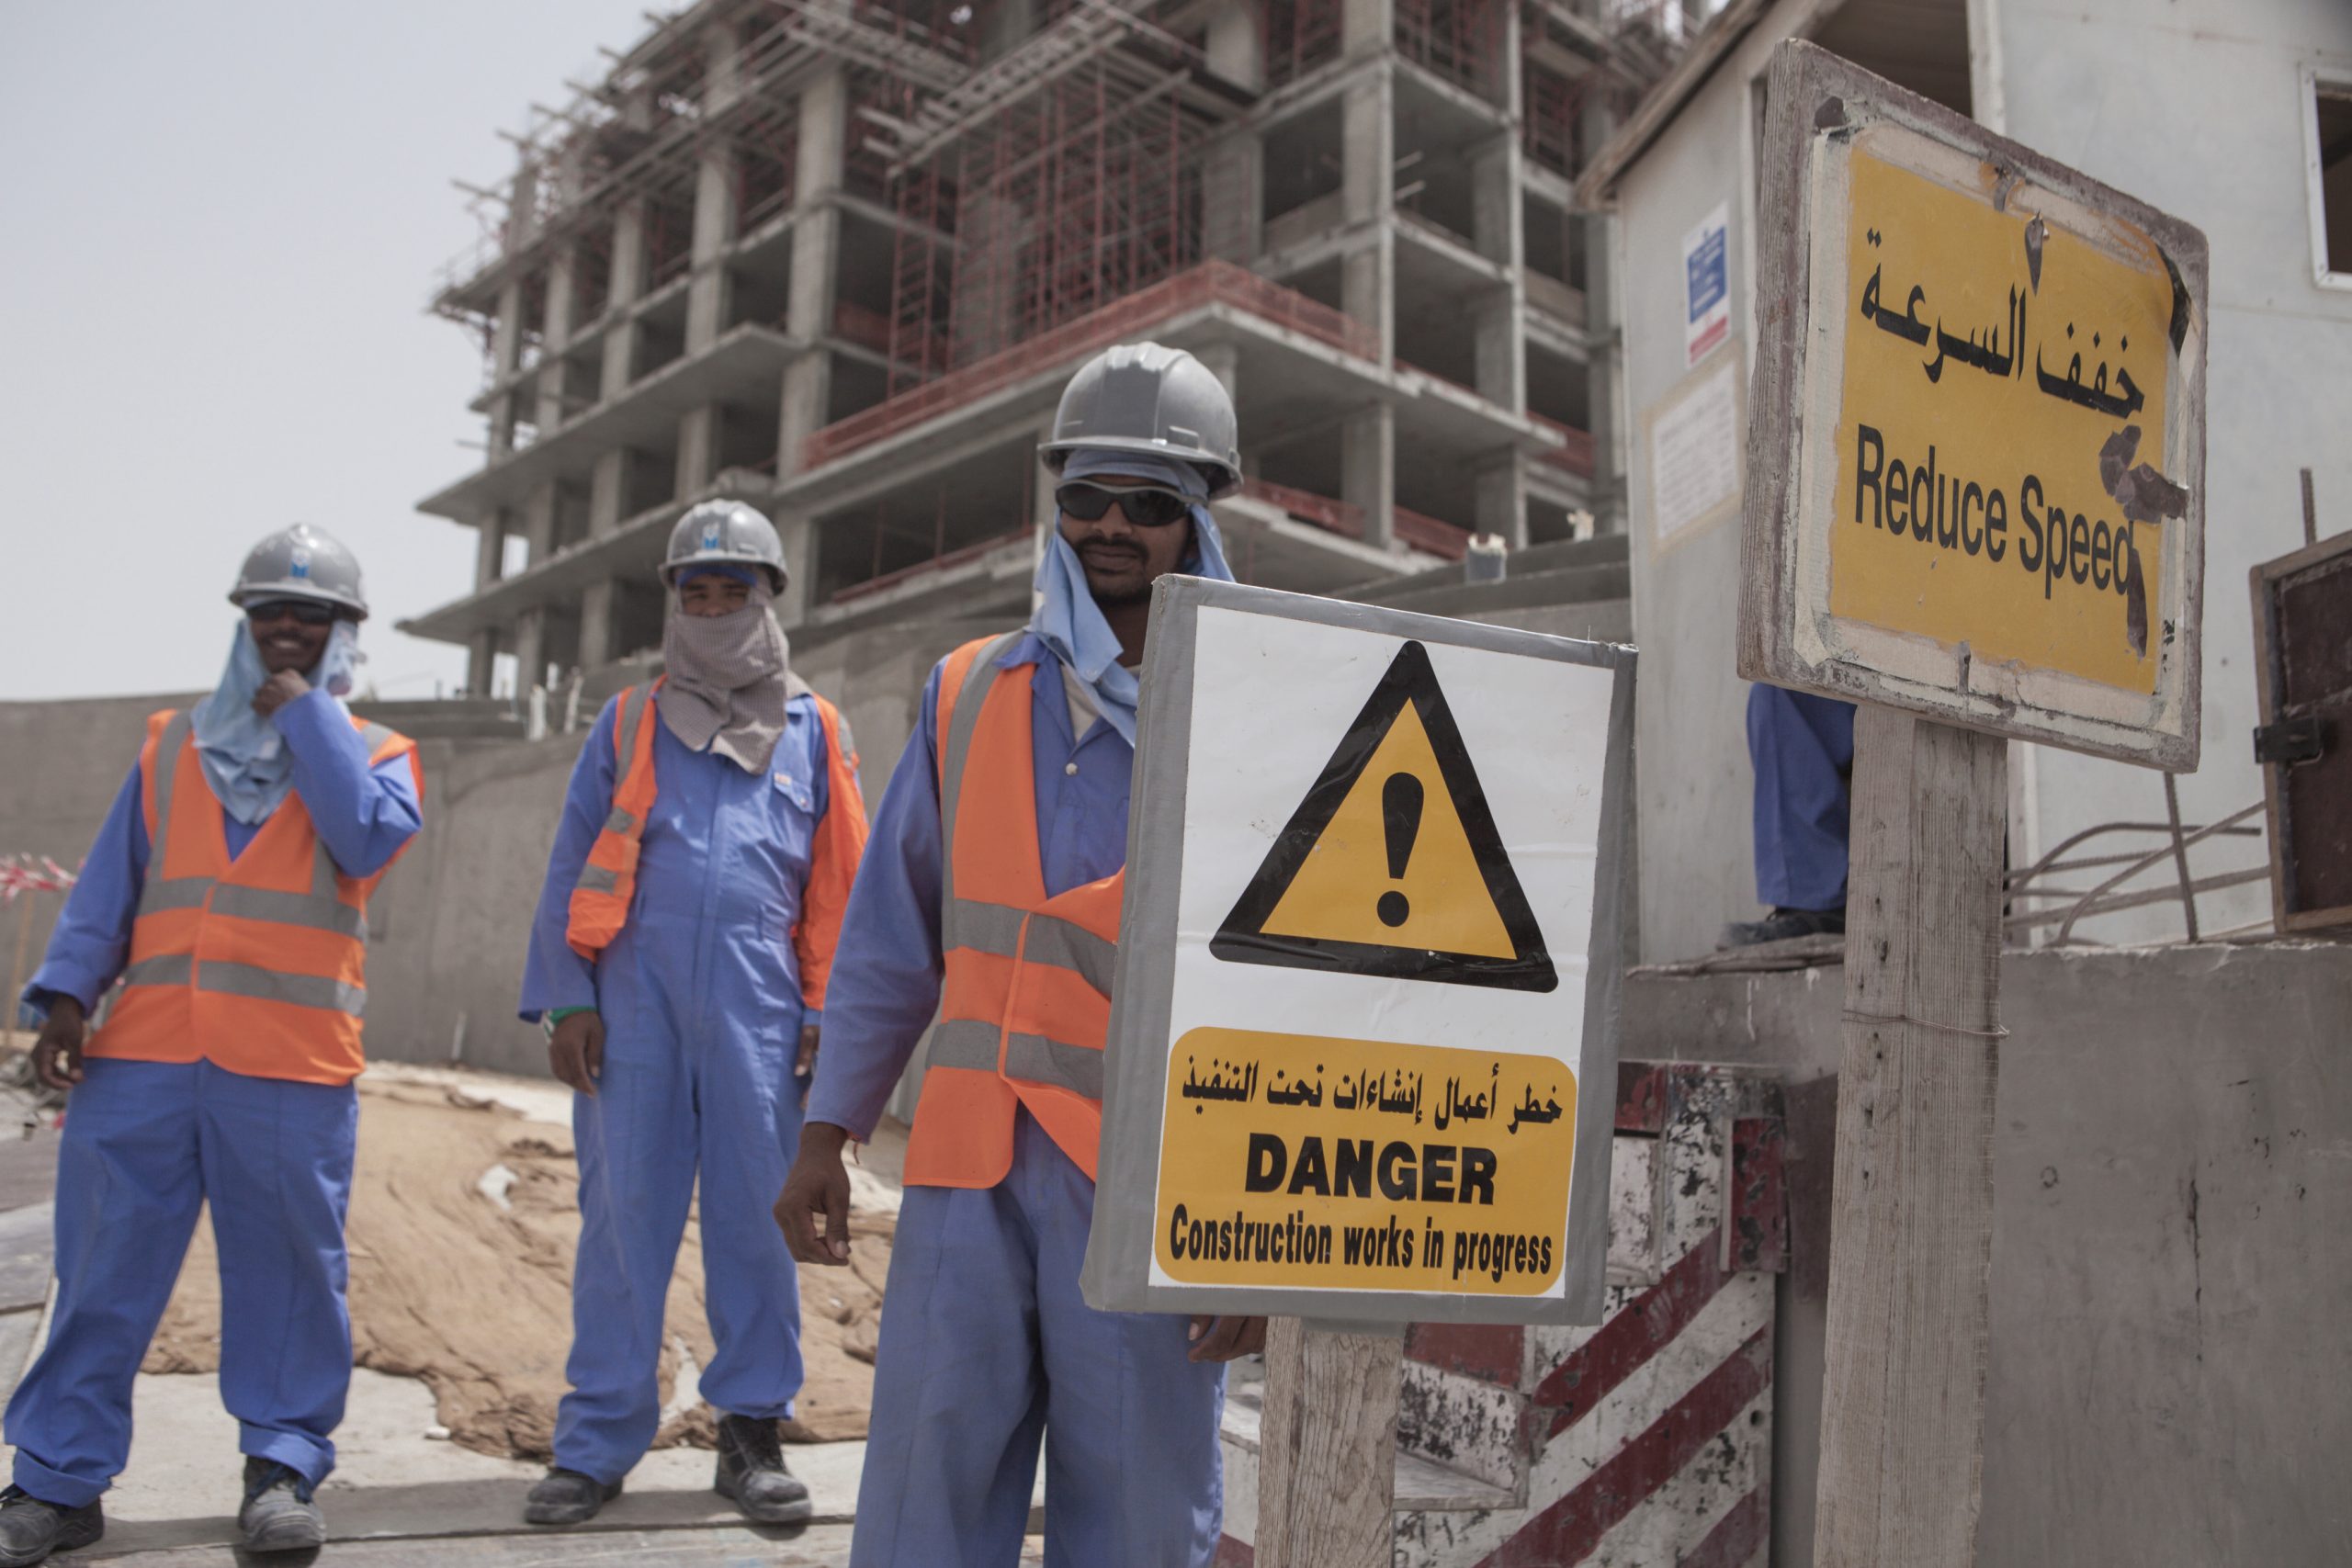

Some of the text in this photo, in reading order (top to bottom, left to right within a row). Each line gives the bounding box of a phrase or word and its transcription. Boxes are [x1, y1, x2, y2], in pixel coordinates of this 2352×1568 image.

[1860, 227, 2026, 384] السرعة
[2036, 321, 2146, 420] خفف
[1855, 423, 2007, 562] Reduce
[2018, 474, 2134, 600] Speed
[1182, 1055, 1563, 1135] خطر أعمال إنشاءات تحت التنفيذ
[1245, 1133, 1498, 1206] DANGER
[1170, 1203, 1552, 1283] Construction works in progress
